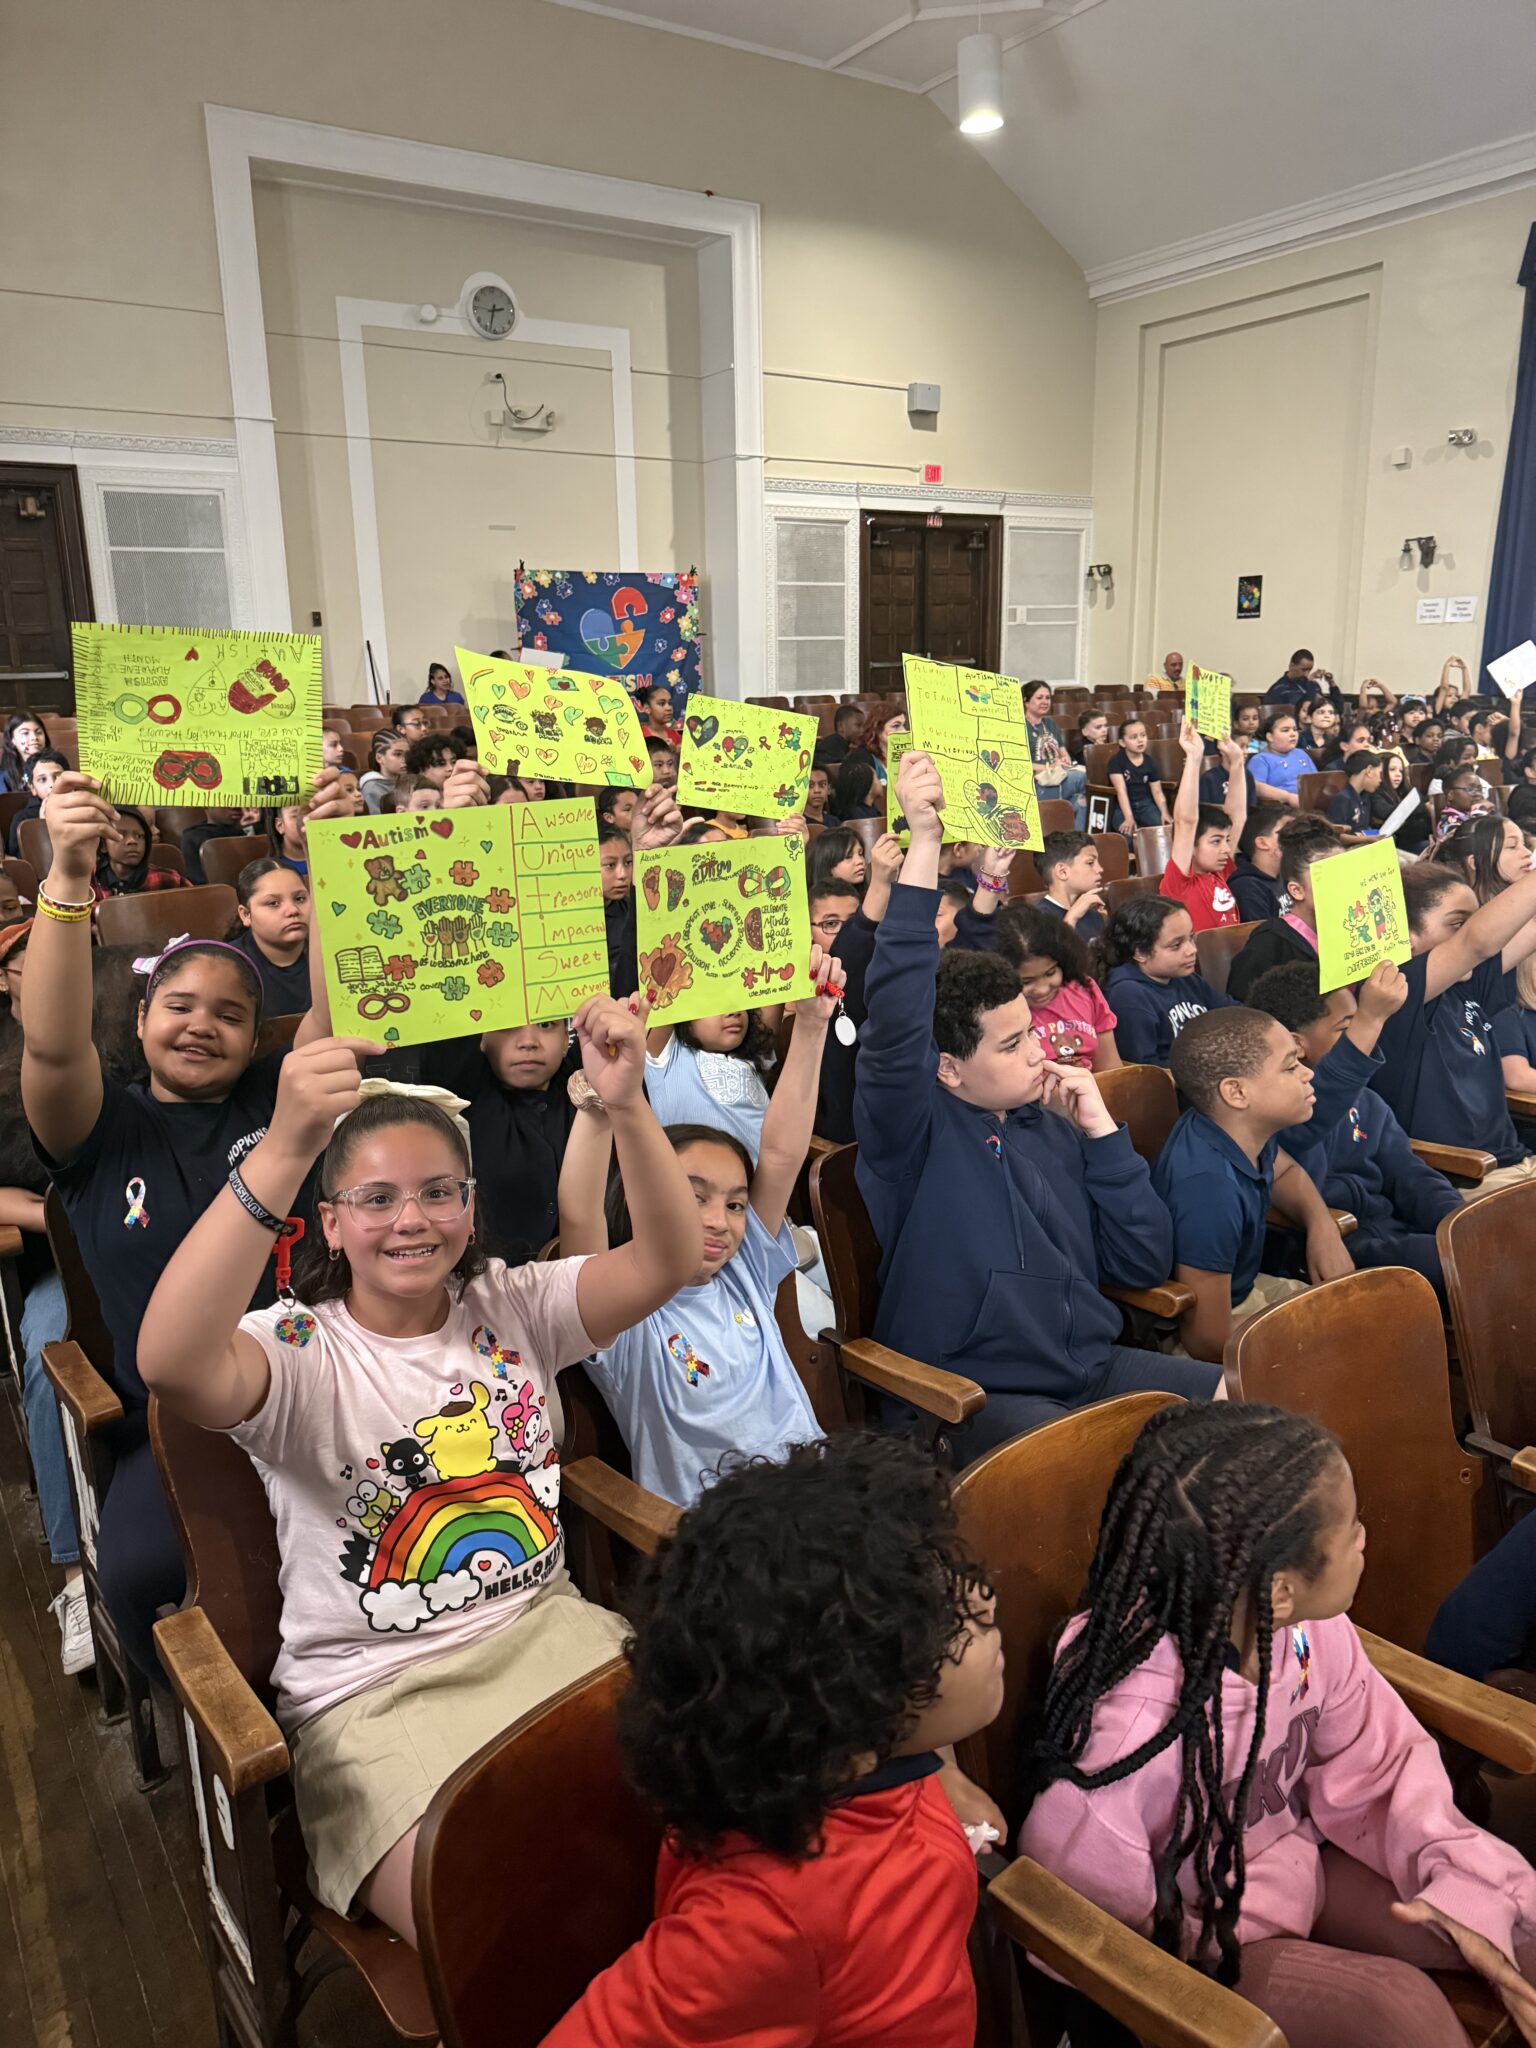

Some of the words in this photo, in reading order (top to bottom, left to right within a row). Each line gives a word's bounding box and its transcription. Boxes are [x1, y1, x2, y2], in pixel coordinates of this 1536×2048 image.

[362, 825, 429, 850] Autism
[521, 843, 596, 873] Unique
[412, 894, 487, 921] EVERYONE
[537, 950, 602, 979] Sweet
[484, 1560, 543, 1601] HELLO
